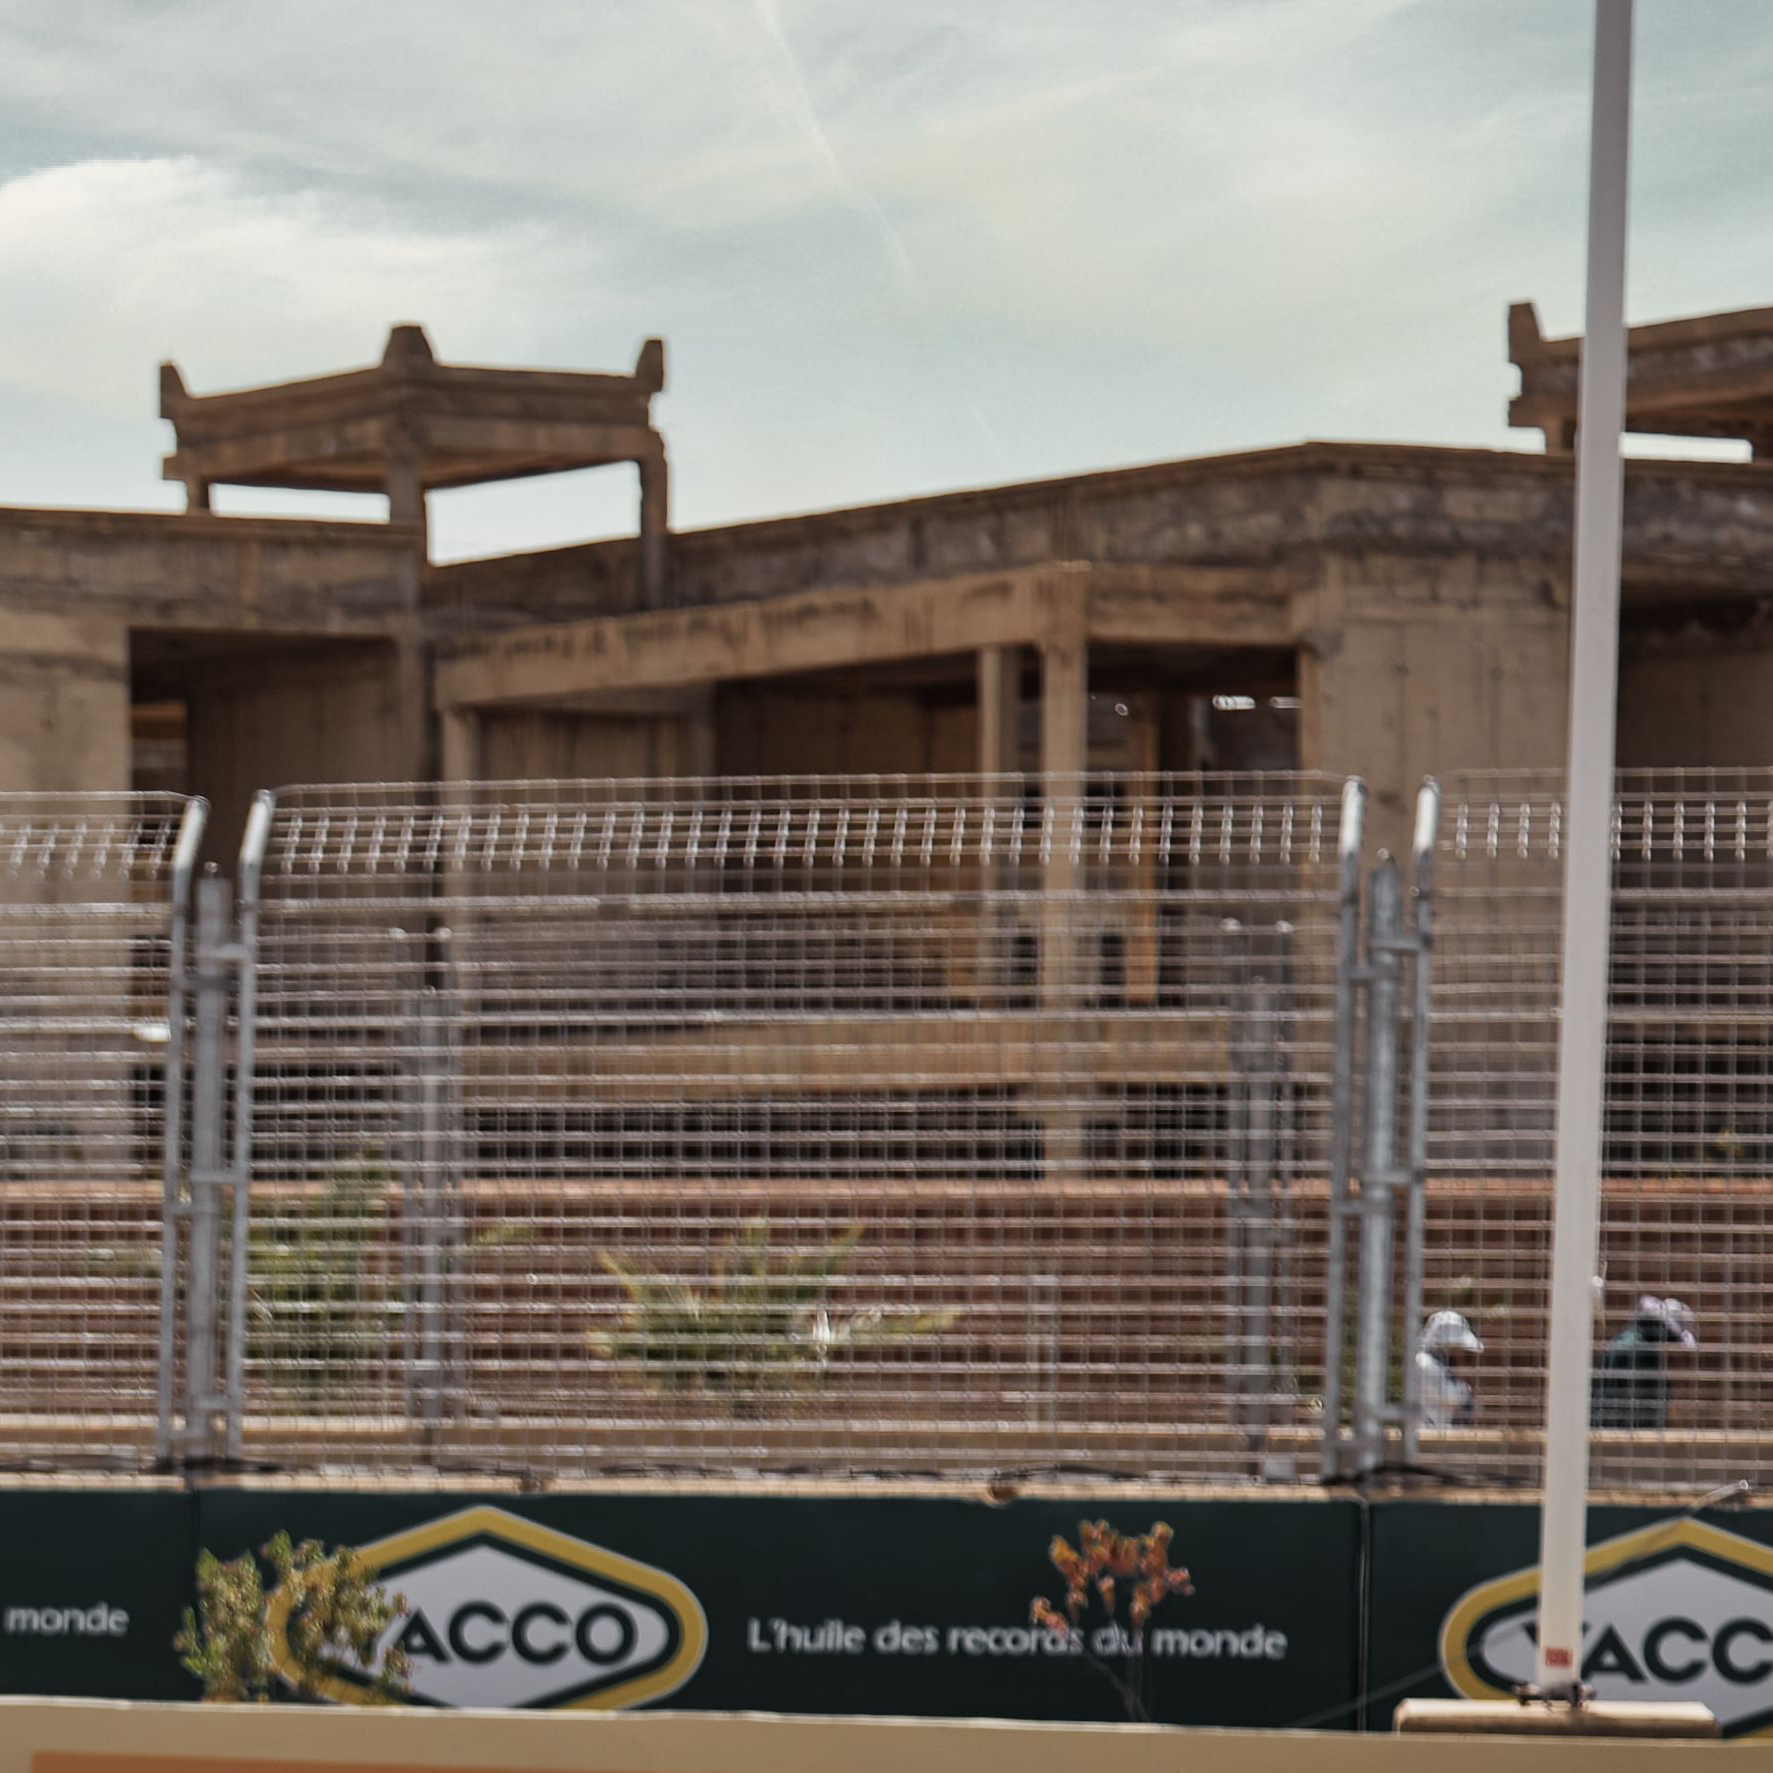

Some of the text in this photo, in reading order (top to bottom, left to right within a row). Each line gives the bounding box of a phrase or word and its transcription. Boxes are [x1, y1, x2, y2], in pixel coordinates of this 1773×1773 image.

[4, 1601, 131, 1635] monde
[357, 1600, 639, 1667] ACCO
[874, 1621, 940, 1654] des
[1153, 1624, 1288, 1660] monde
